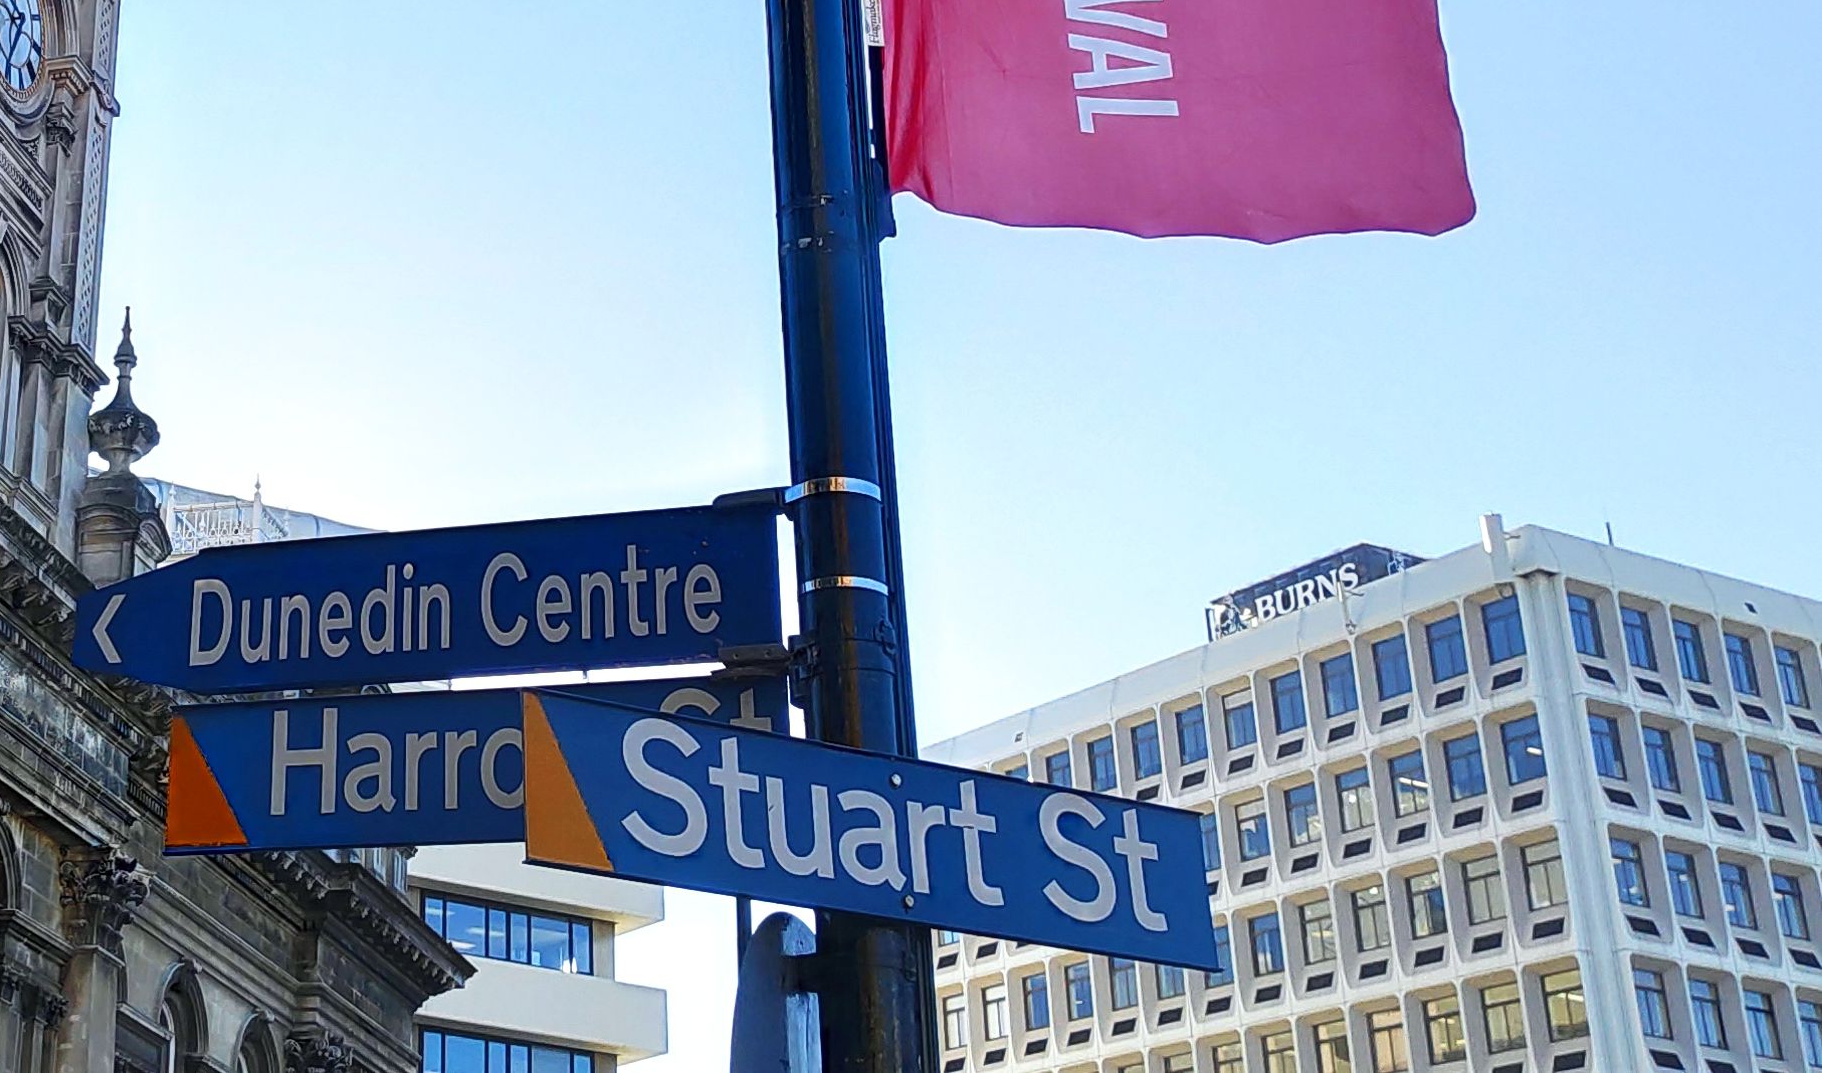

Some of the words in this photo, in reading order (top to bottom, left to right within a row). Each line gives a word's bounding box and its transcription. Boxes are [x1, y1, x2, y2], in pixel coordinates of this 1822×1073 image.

[189, 562, 451, 667] Dunedin
[481, 544, 722, 646] Centre
[1254, 562, 1359, 623] BURNS
[270, 707, 524, 817] Harro
[621, 717, 1006, 907] Stuart
[1039, 792, 1169, 933] St
